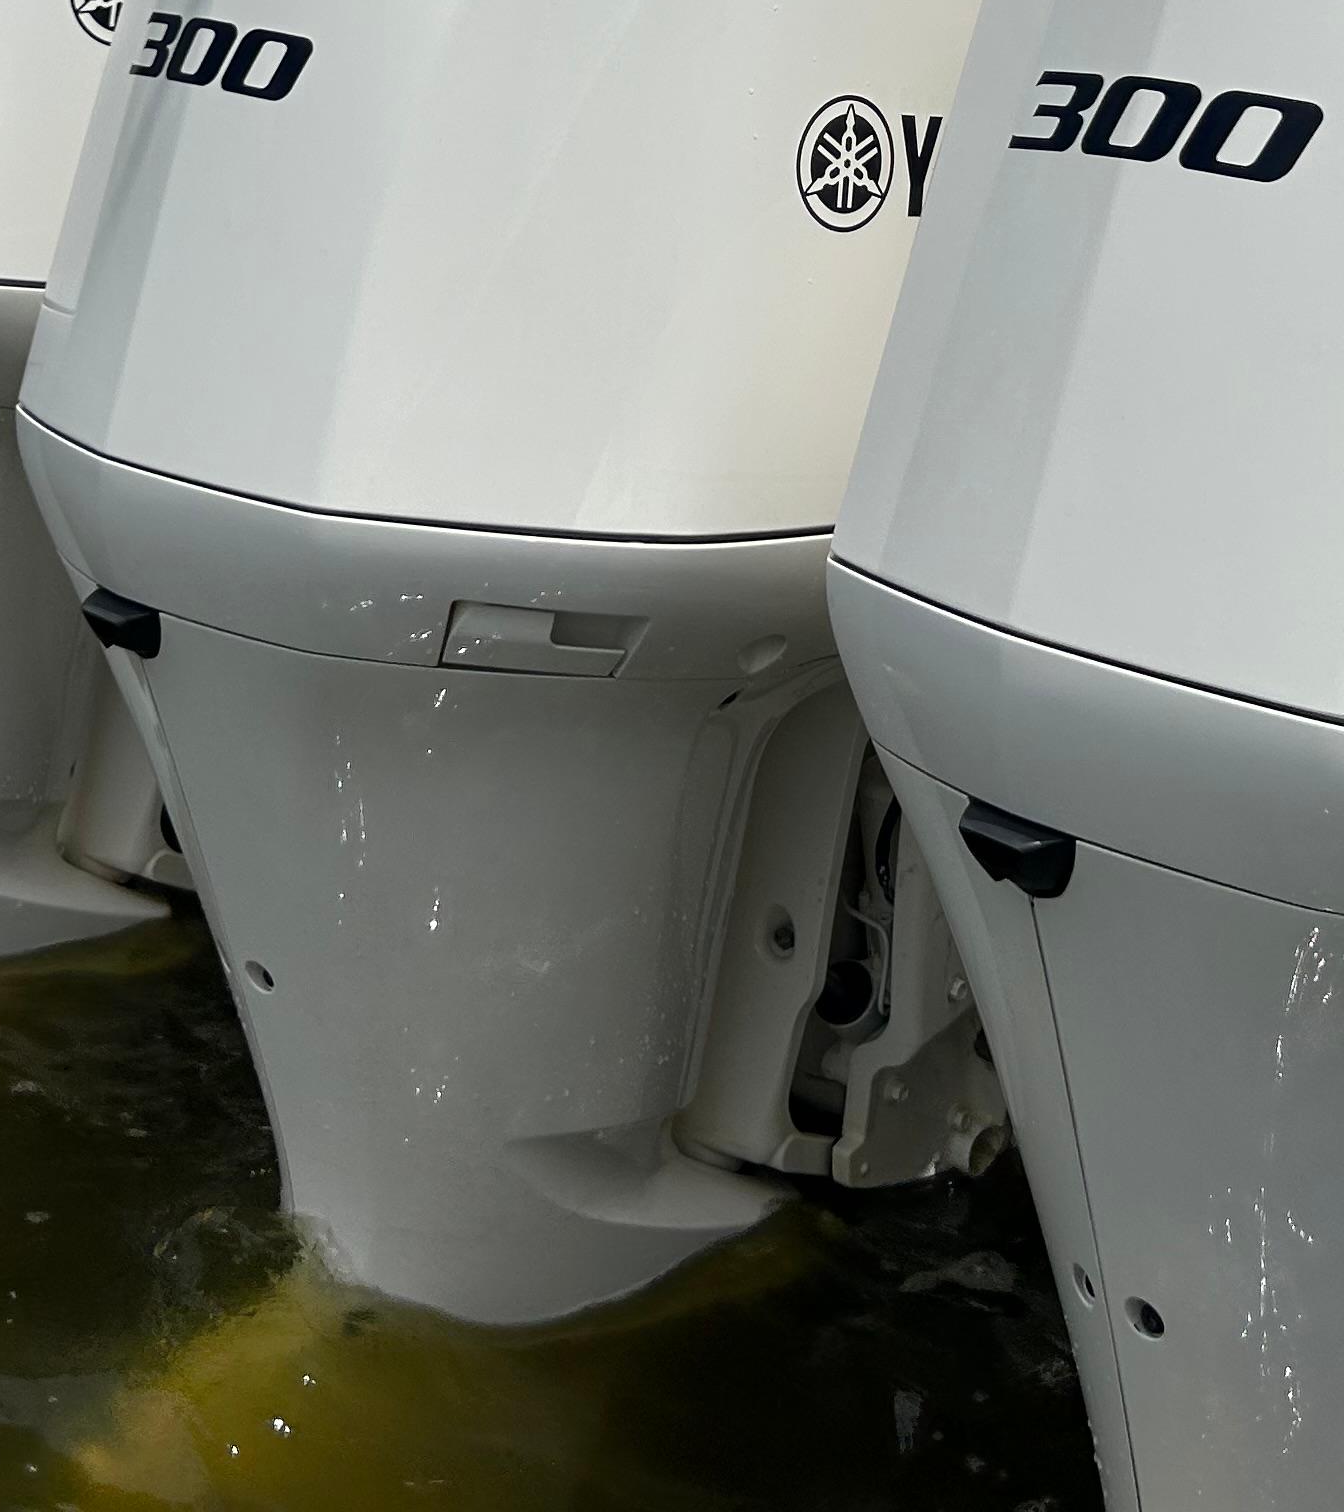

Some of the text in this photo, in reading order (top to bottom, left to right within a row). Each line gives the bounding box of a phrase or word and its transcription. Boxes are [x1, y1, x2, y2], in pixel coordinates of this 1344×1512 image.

[129, 11, 314, 101] 300
[901, 114, 944, 217] Y
[1008, 70, 1324, 183] 300
